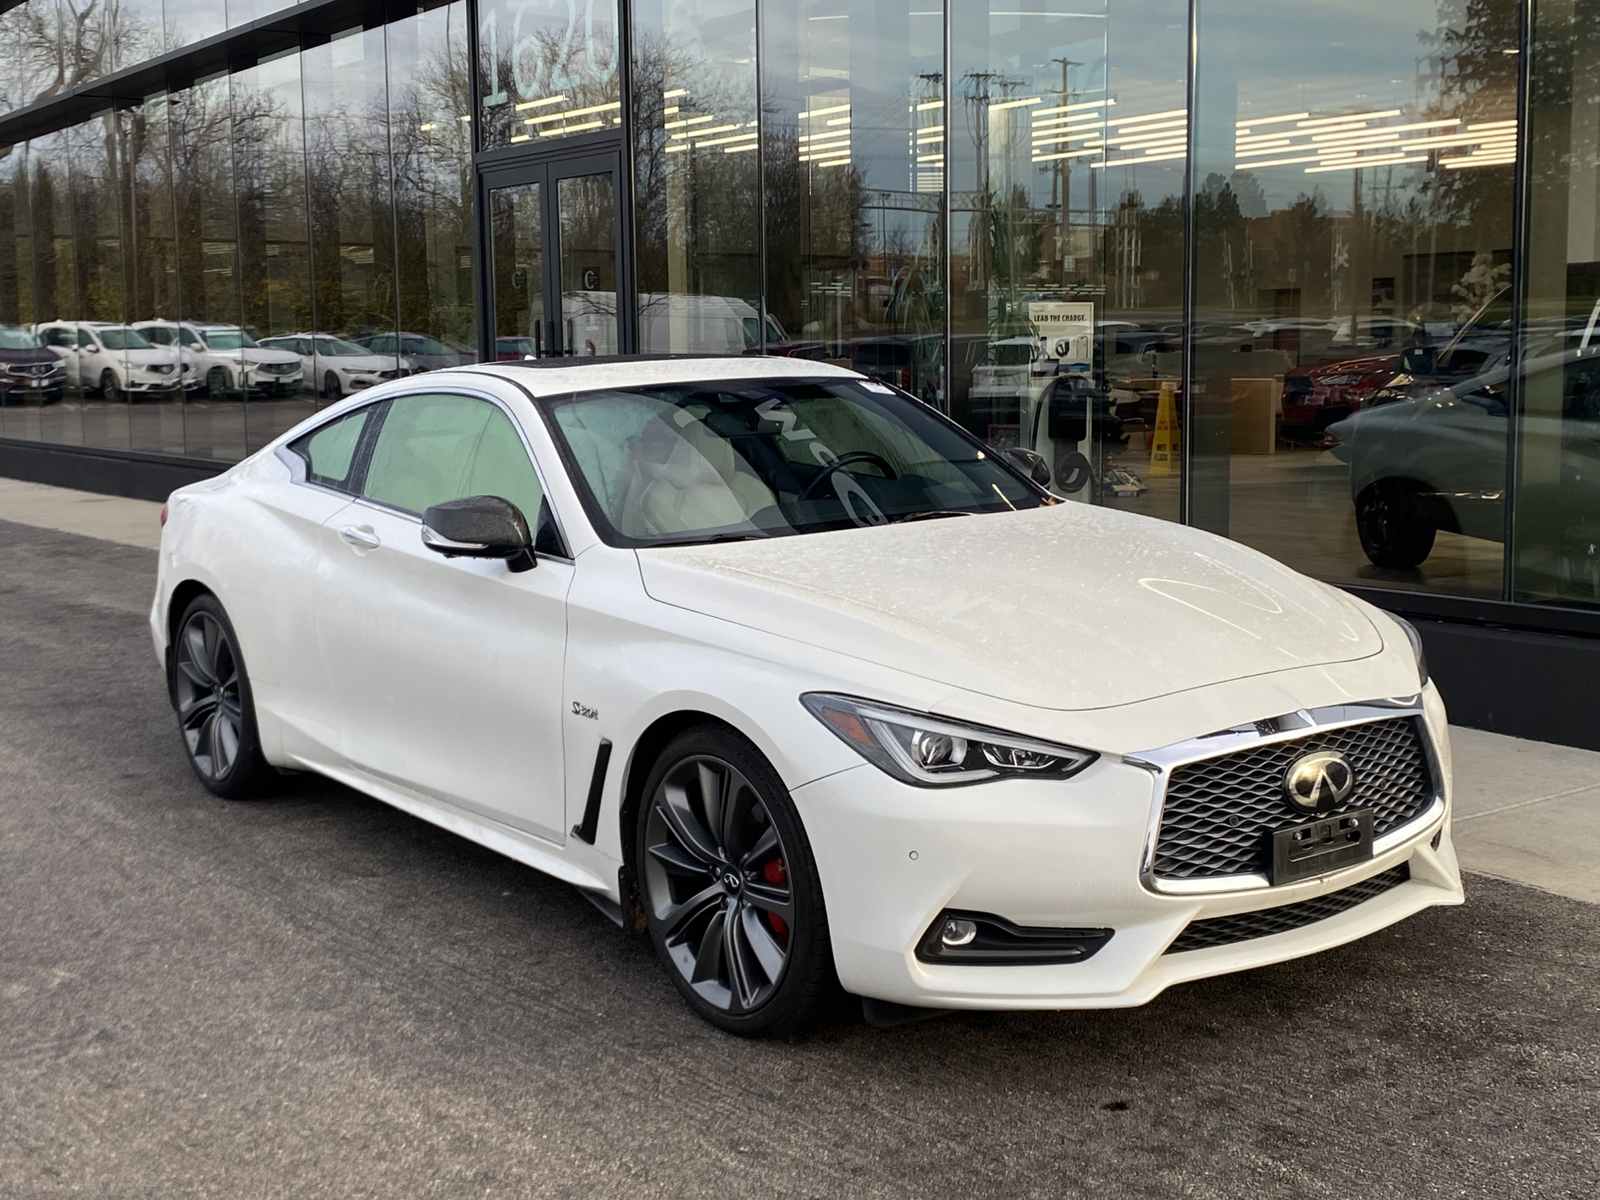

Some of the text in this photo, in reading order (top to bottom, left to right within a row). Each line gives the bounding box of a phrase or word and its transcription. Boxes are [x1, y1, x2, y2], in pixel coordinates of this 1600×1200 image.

[481, 0, 619, 107] 1620
[1034, 314, 1087, 322] LEAD THE CHARGE.
